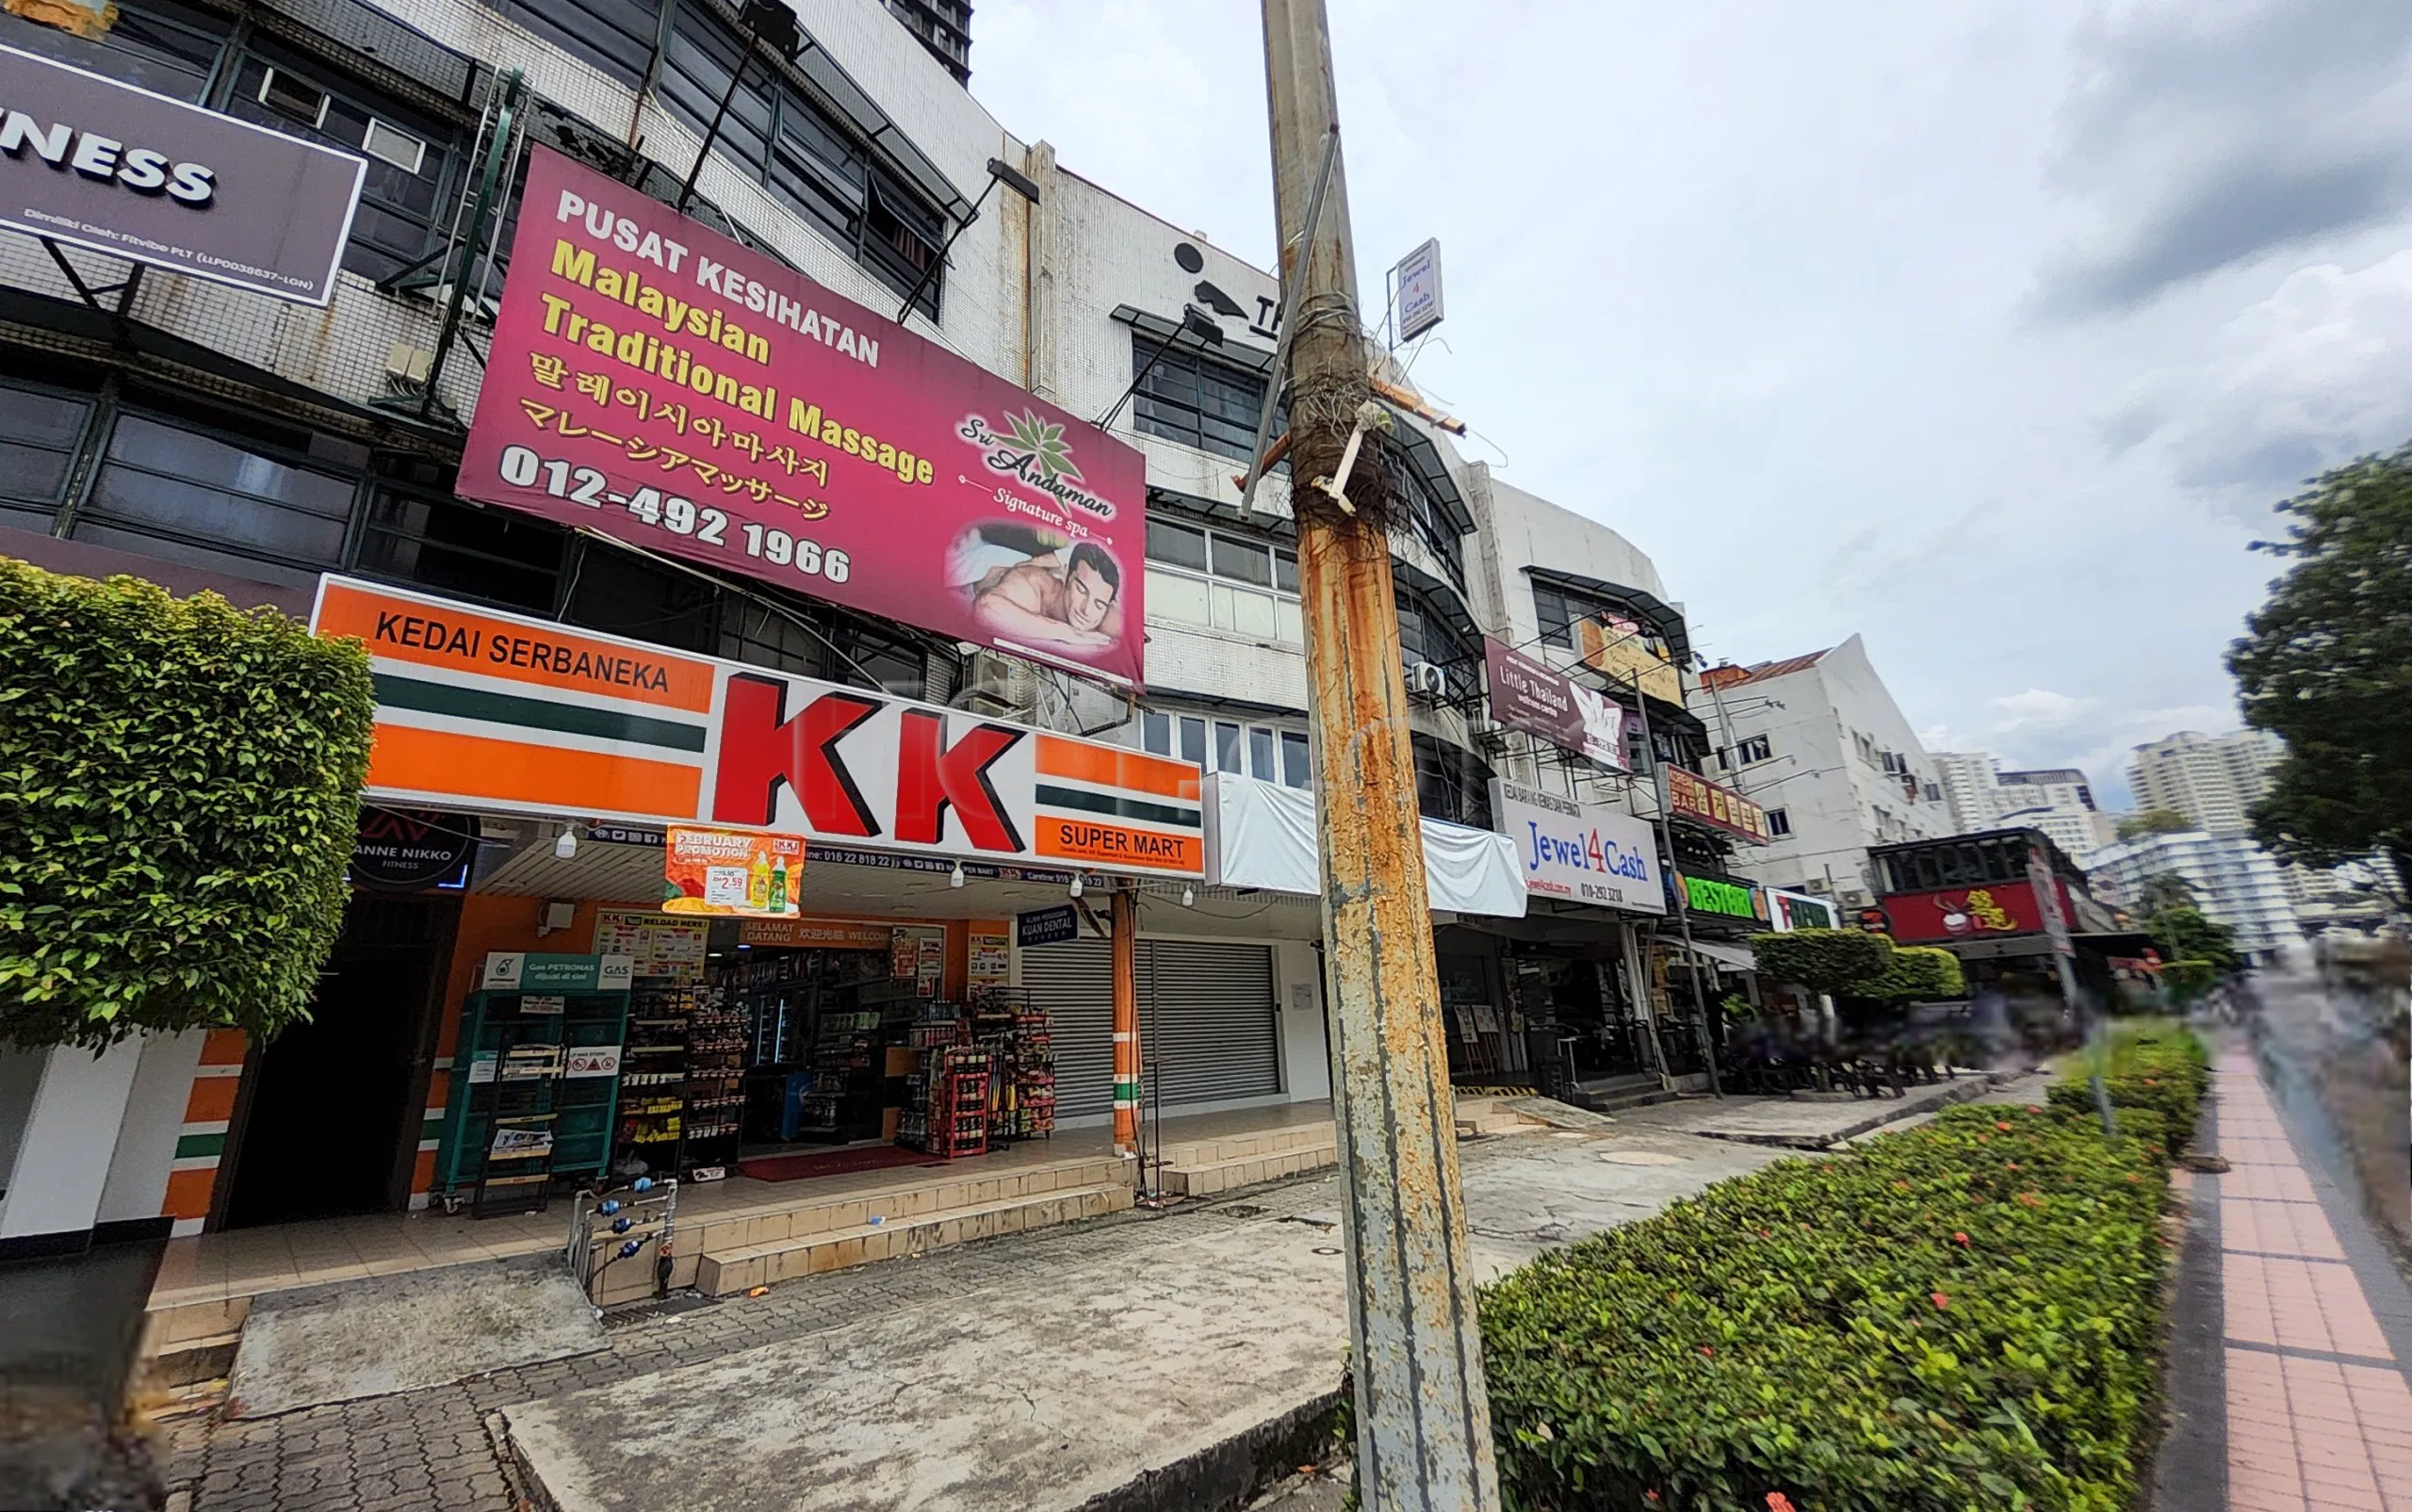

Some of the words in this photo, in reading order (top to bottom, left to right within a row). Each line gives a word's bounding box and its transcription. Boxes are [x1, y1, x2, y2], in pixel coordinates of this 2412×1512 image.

[171, 246, 194, 260] PLT
[557, 189, 688, 273] PUSAT
[696, 256, 879, 368] KESIHATAN
[550, 238, 772, 367] Malaysian
[542, 291, 777, 422] Traditional
[788, 397, 934, 485] Massage
[960, 418, 995, 447] Sri
[518, 397, 831, 521] マレーシアマッサージ
[986, 449, 1113, 517] Andaman
[499, 444, 728, 546] 012-492
[741, 522, 851, 585] 1966
[992, 486, 1063, 528] Signature
[1065, 520, 1089, 539] spa
[376, 610, 481, 659] KEDAI
[488, 633, 670, 693] SERBANEKA
[1499, 665, 1528, 694] Little
[1529, 680, 1569, 712] Thailand
[711, 671, 1030, 854] KK
[1671, 789, 1698, 813] BAR
[676, 831, 755, 849] FEBRUARY
[1060, 824, 1130, 854] SUPER
[1133, 833, 1184, 859] MART
[401, 847, 452, 861] NIKKO
[675, 844, 751, 860] PROMOTION
[844, 853, 856, 863] 22
[878, 855, 890, 866] 22
[382, 859, 419, 870] FITNESS
[721, 876, 742, 889] 2.59
[643, 918, 678, 927] RELOAD
[745, 921, 794, 934] SELAMAT
[1022, 921, 1043, 936] KUAN
[1043, 916, 1072, 933] DENTAL
[746, 932, 791, 943] DATANG
[798, 927, 845, 941] 欢迎光临
[529, 963, 546, 971] Gas
[546, 963, 595, 972] PETRONAS
[571, 972, 587, 981] sini
[604, 965, 629, 975] GAS
